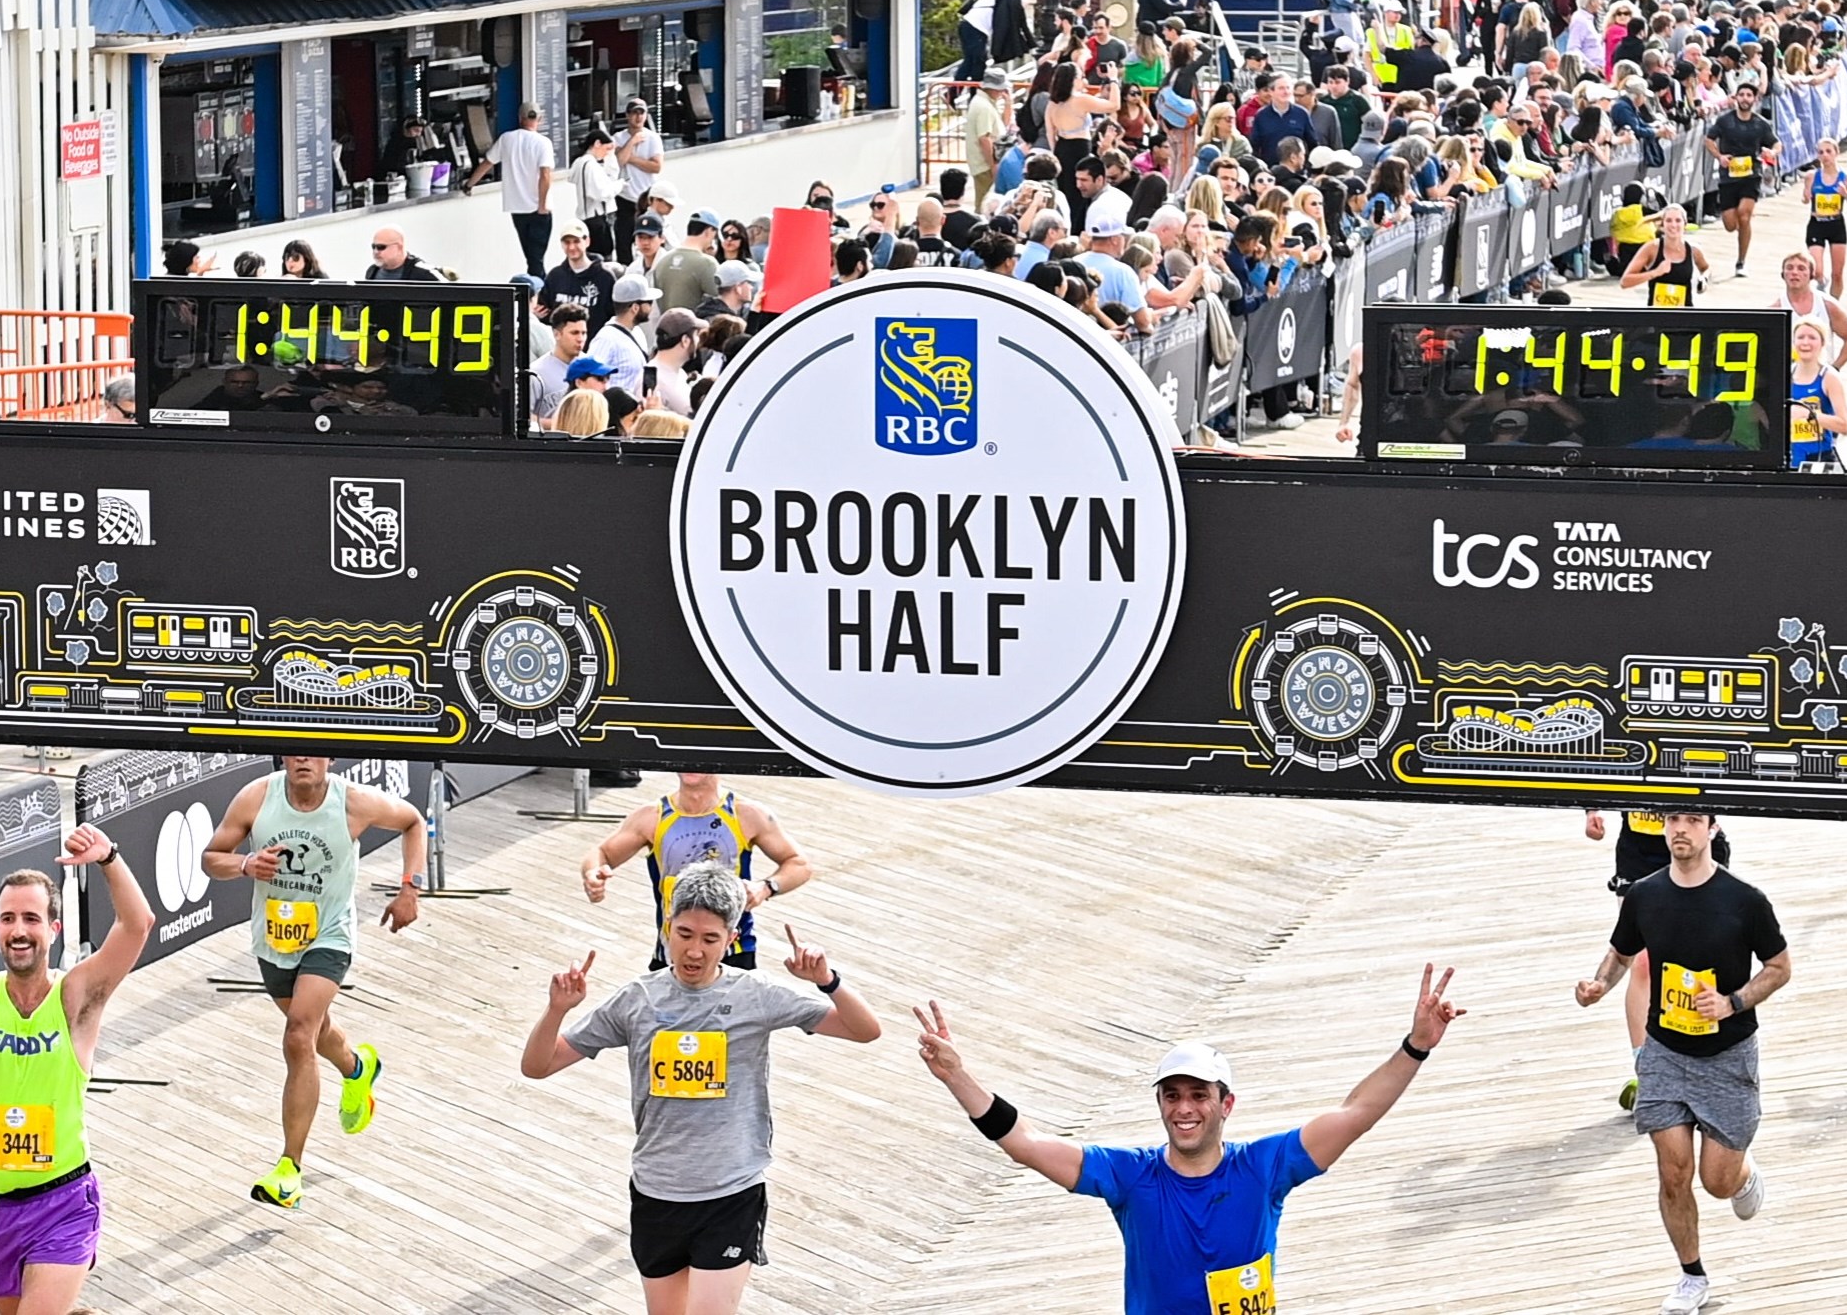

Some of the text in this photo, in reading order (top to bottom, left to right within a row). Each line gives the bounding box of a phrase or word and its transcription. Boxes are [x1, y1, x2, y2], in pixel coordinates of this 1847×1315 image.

[62, 127, 100, 142] No Outside
[68, 143, 88, 158] Food
[886, 415, 968, 445] RBC
[719, 487, 1137, 583] BROOKLYN
[1554, 521, 1621, 543] TATA
[341, 547, 397, 571] RBC
[1432, 518, 1540, 589] tcs
[1554, 546, 1712, 571] CONSULTANCY
[1554, 569, 1653, 593] SERVICES
[827, 587, 1026, 677] HALF
[490, 626, 561, 665] WONDER
[495, 671, 558, 701] WHEEL
[1290, 657, 1366, 697] WONDER
[1296, 703, 1361, 732] WHEEL
[277, 829, 310, 842] ATLETICO
[159, 900, 213, 943] mastercard
[267, 919, 310, 942] E 11607
[655, 1060, 715, 1081] C 5864
[2, 1133, 40, 1155] 3441
